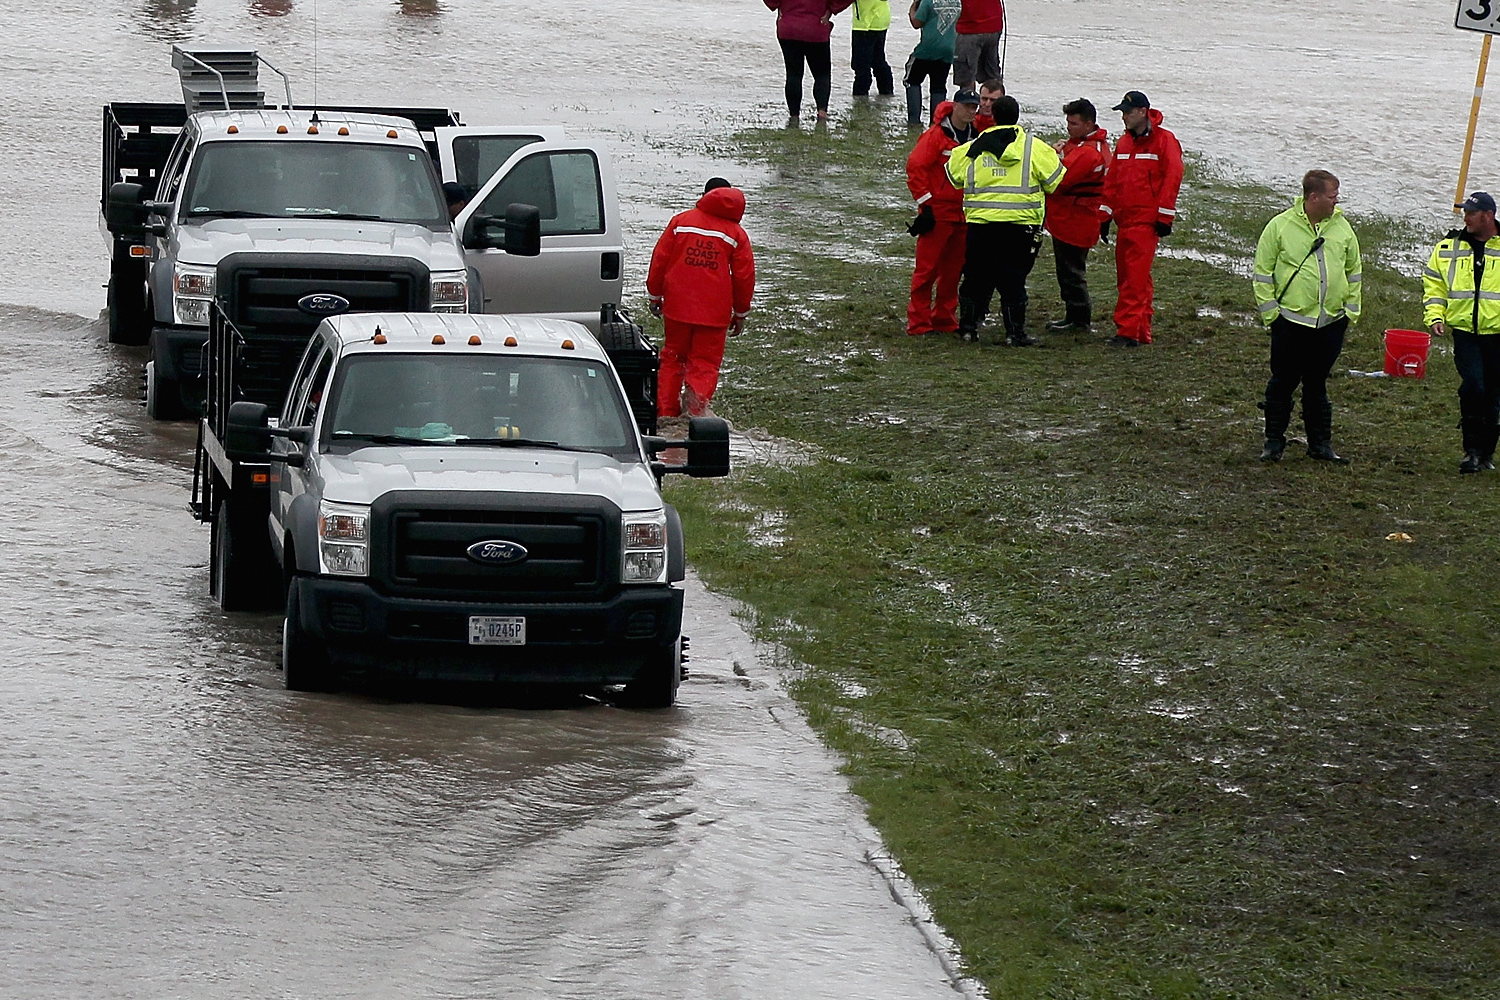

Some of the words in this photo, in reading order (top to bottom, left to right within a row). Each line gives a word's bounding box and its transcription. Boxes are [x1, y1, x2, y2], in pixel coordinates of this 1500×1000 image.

[992, 168, 1007, 176] FIRE
[696, 239, 716, 250] U.S.
[686, 247, 720, 260] COAST
[685, 256, 719, 270] GUARD
[309, 296, 338, 310] Ford
[481, 543, 514, 559] Ford
[488, 623, 521, 637] 0245P
